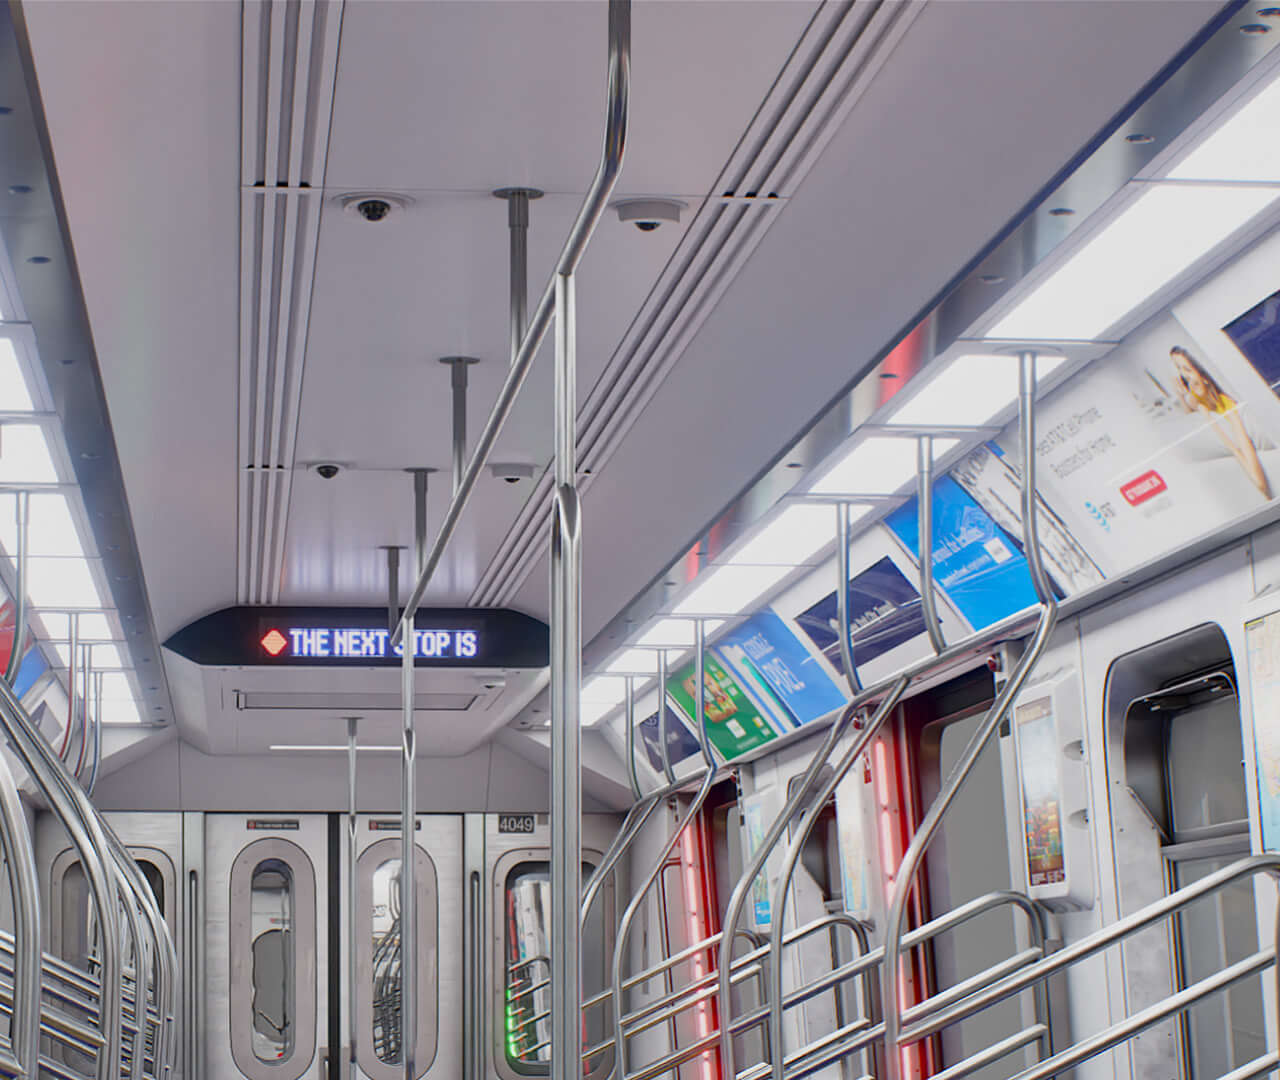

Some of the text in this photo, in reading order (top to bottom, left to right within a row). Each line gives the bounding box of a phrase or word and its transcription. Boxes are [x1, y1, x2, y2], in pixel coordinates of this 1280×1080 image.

[289, 629, 329, 656] THE
[334, 629, 389, 656] NEXT
[455, 631, 478, 657] IS
[499, 816, 534, 832] 4049
